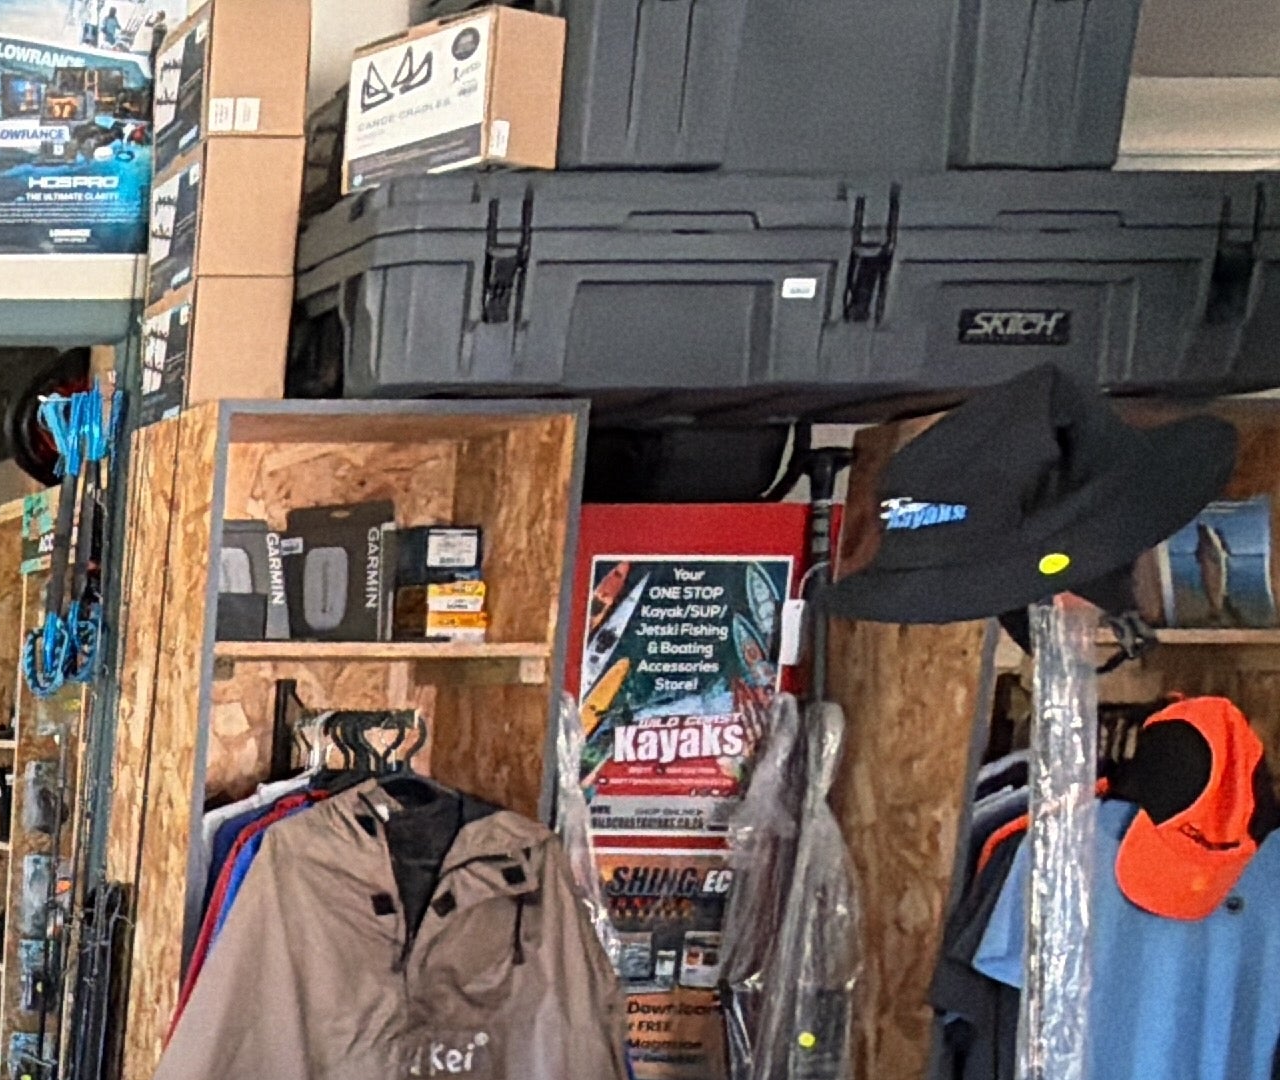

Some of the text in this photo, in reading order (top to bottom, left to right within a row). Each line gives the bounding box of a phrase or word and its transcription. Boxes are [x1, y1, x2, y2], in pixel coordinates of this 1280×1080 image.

[266, 532, 287, 606] GARMIN
[365, 526, 380, 609] GARMIN
[673, 567, 706, 582] Your
[649, 587, 725, 600] ONE STOP
[641, 604, 728, 619] Kayak/SUP/
[635, 623, 729, 640] Jetski Fishing
[647, 642, 714, 657] & Boating
[637, 660, 720, 673] Accessories
[654, 678, 699, 691] Store!
[614, 722, 744, 764] Kayaks
[703, 869, 734, 893] EC
